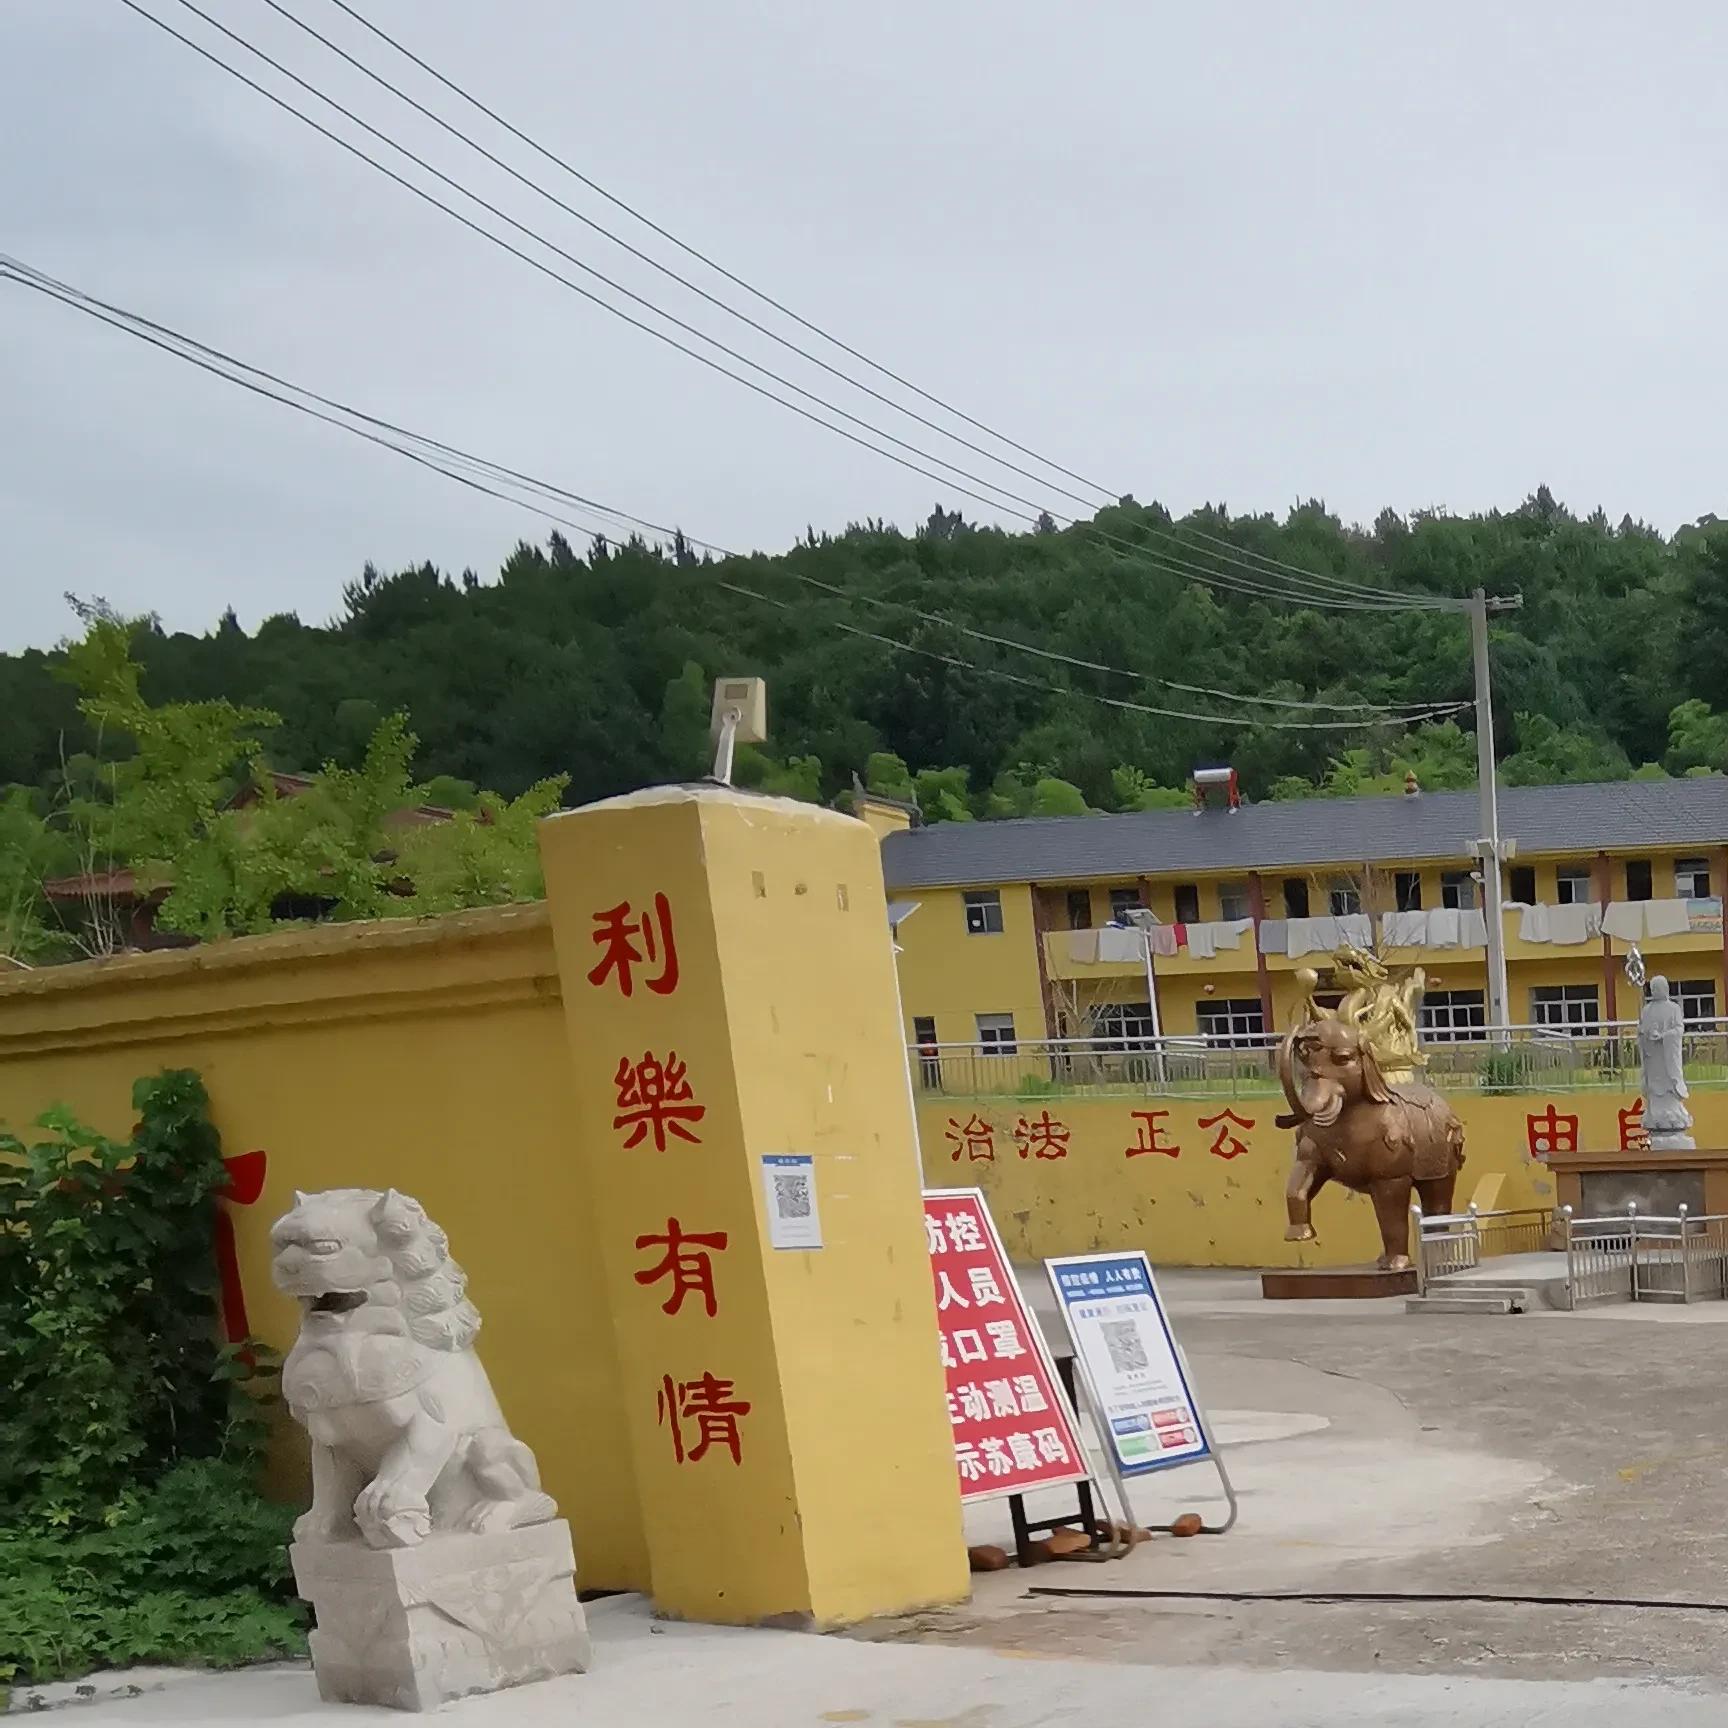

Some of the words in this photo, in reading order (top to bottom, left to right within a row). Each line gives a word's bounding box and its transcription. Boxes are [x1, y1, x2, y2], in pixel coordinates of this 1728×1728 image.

[588, 891, 751, 1467] 利樂有情
[939, 1267, 1006, 1311] 人员
